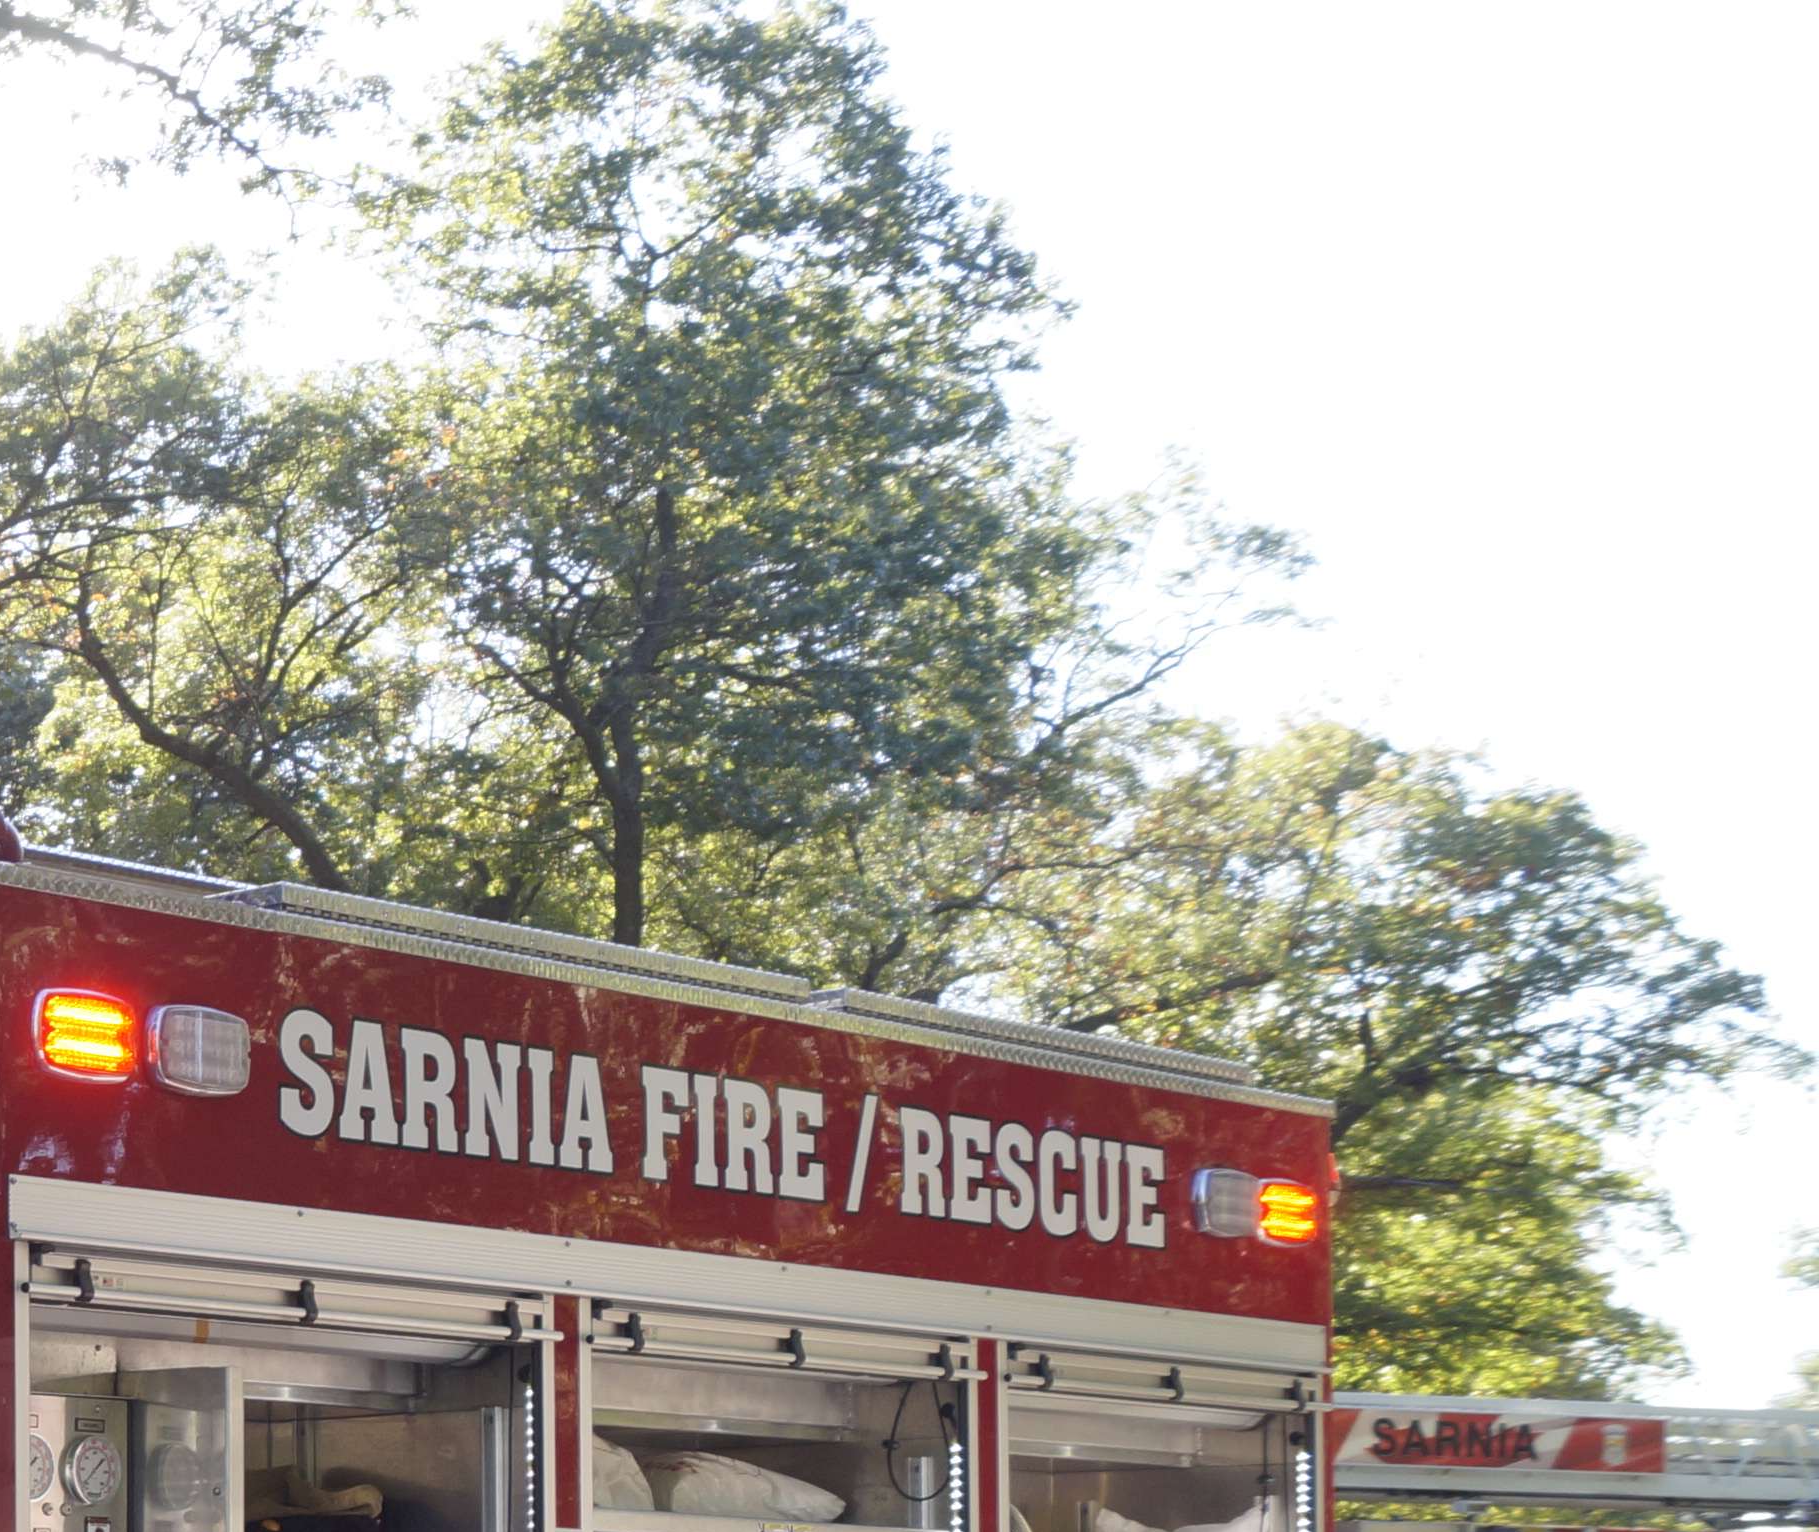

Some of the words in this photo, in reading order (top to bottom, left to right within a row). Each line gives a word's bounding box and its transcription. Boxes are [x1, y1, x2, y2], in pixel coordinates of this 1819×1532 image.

[277, 1006, 614, 1175] SARNIA
[640, 1063, 826, 1203] FIRE
[843, 1092, 877, 1214] /
[899, 1105, 1168, 1251] RESCUE
[1372, 1417, 1539, 1461] SARNIA
